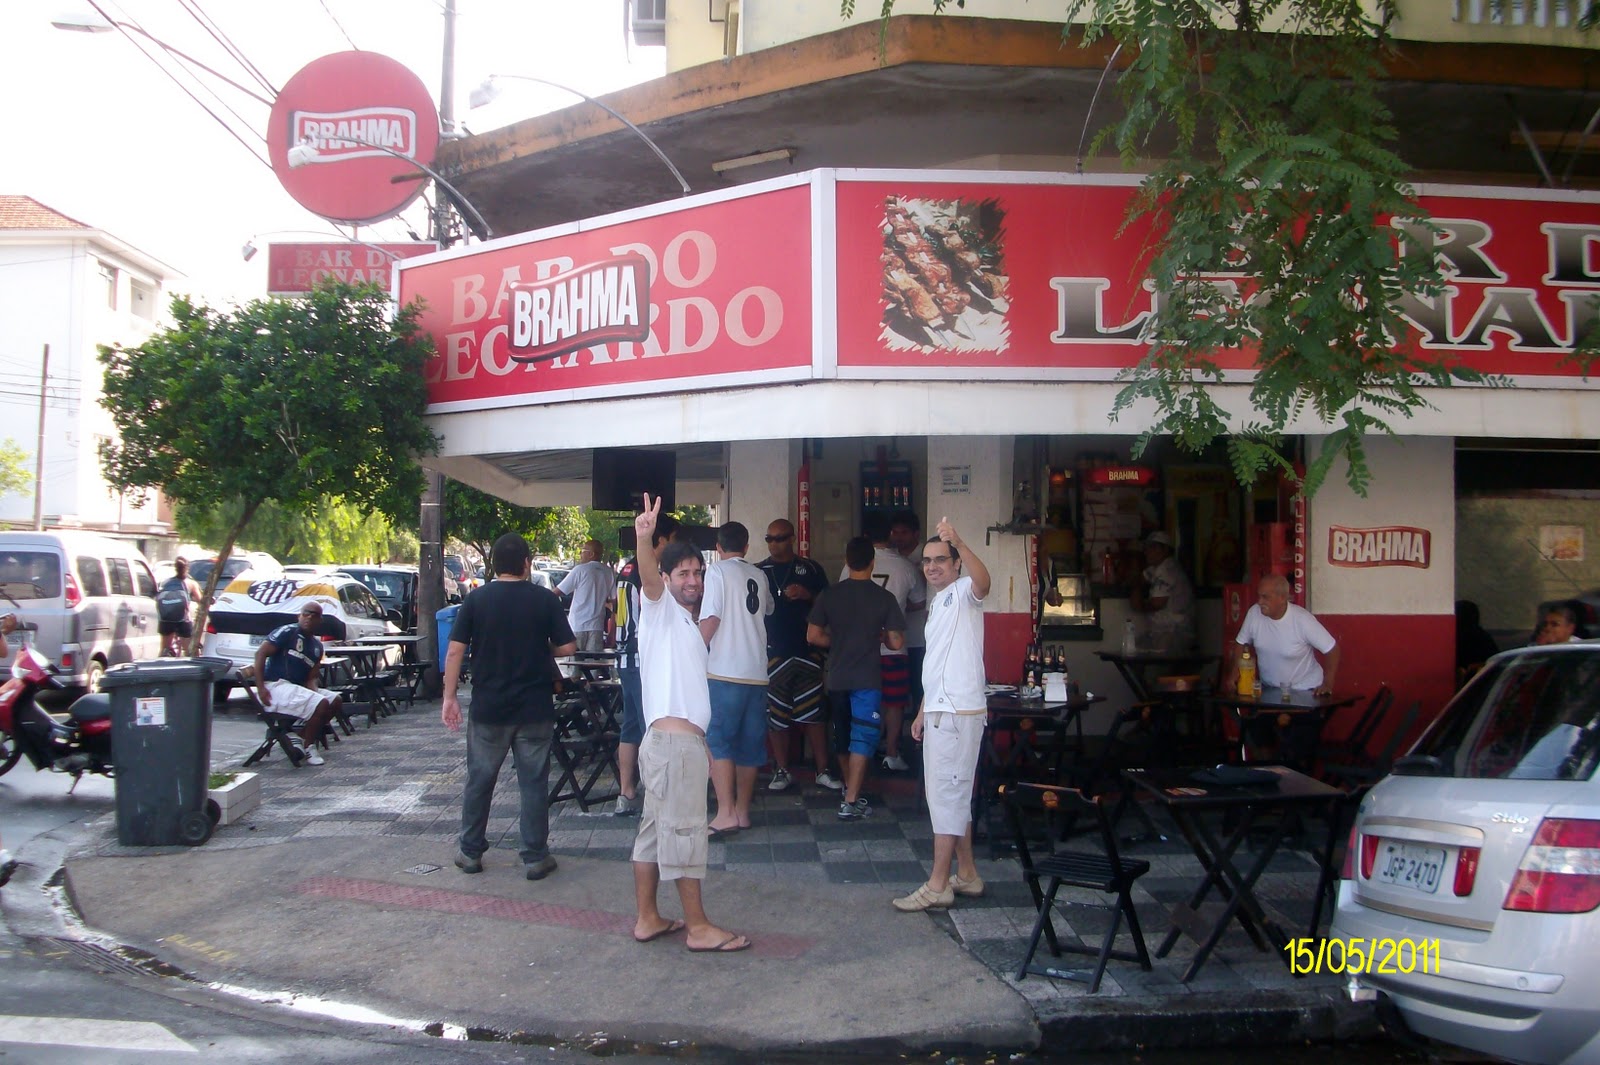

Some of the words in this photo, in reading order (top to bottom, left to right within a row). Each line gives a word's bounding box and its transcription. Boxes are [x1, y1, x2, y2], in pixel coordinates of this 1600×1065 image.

[304, 118, 404, 149] BRAHMA
[295, 249, 354, 267] BAR
[1177, 212, 1508, 284] BR
[513, 265, 639, 347] BRAHMA
[422, 286, 784, 384] EORDO
[1108, 470, 1139, 481] BRAHMA
[1332, 530, 1426, 564] BRAHMA
[746, 578, 760, 615] 8
[1405, 860, 1437, 886] 2470
